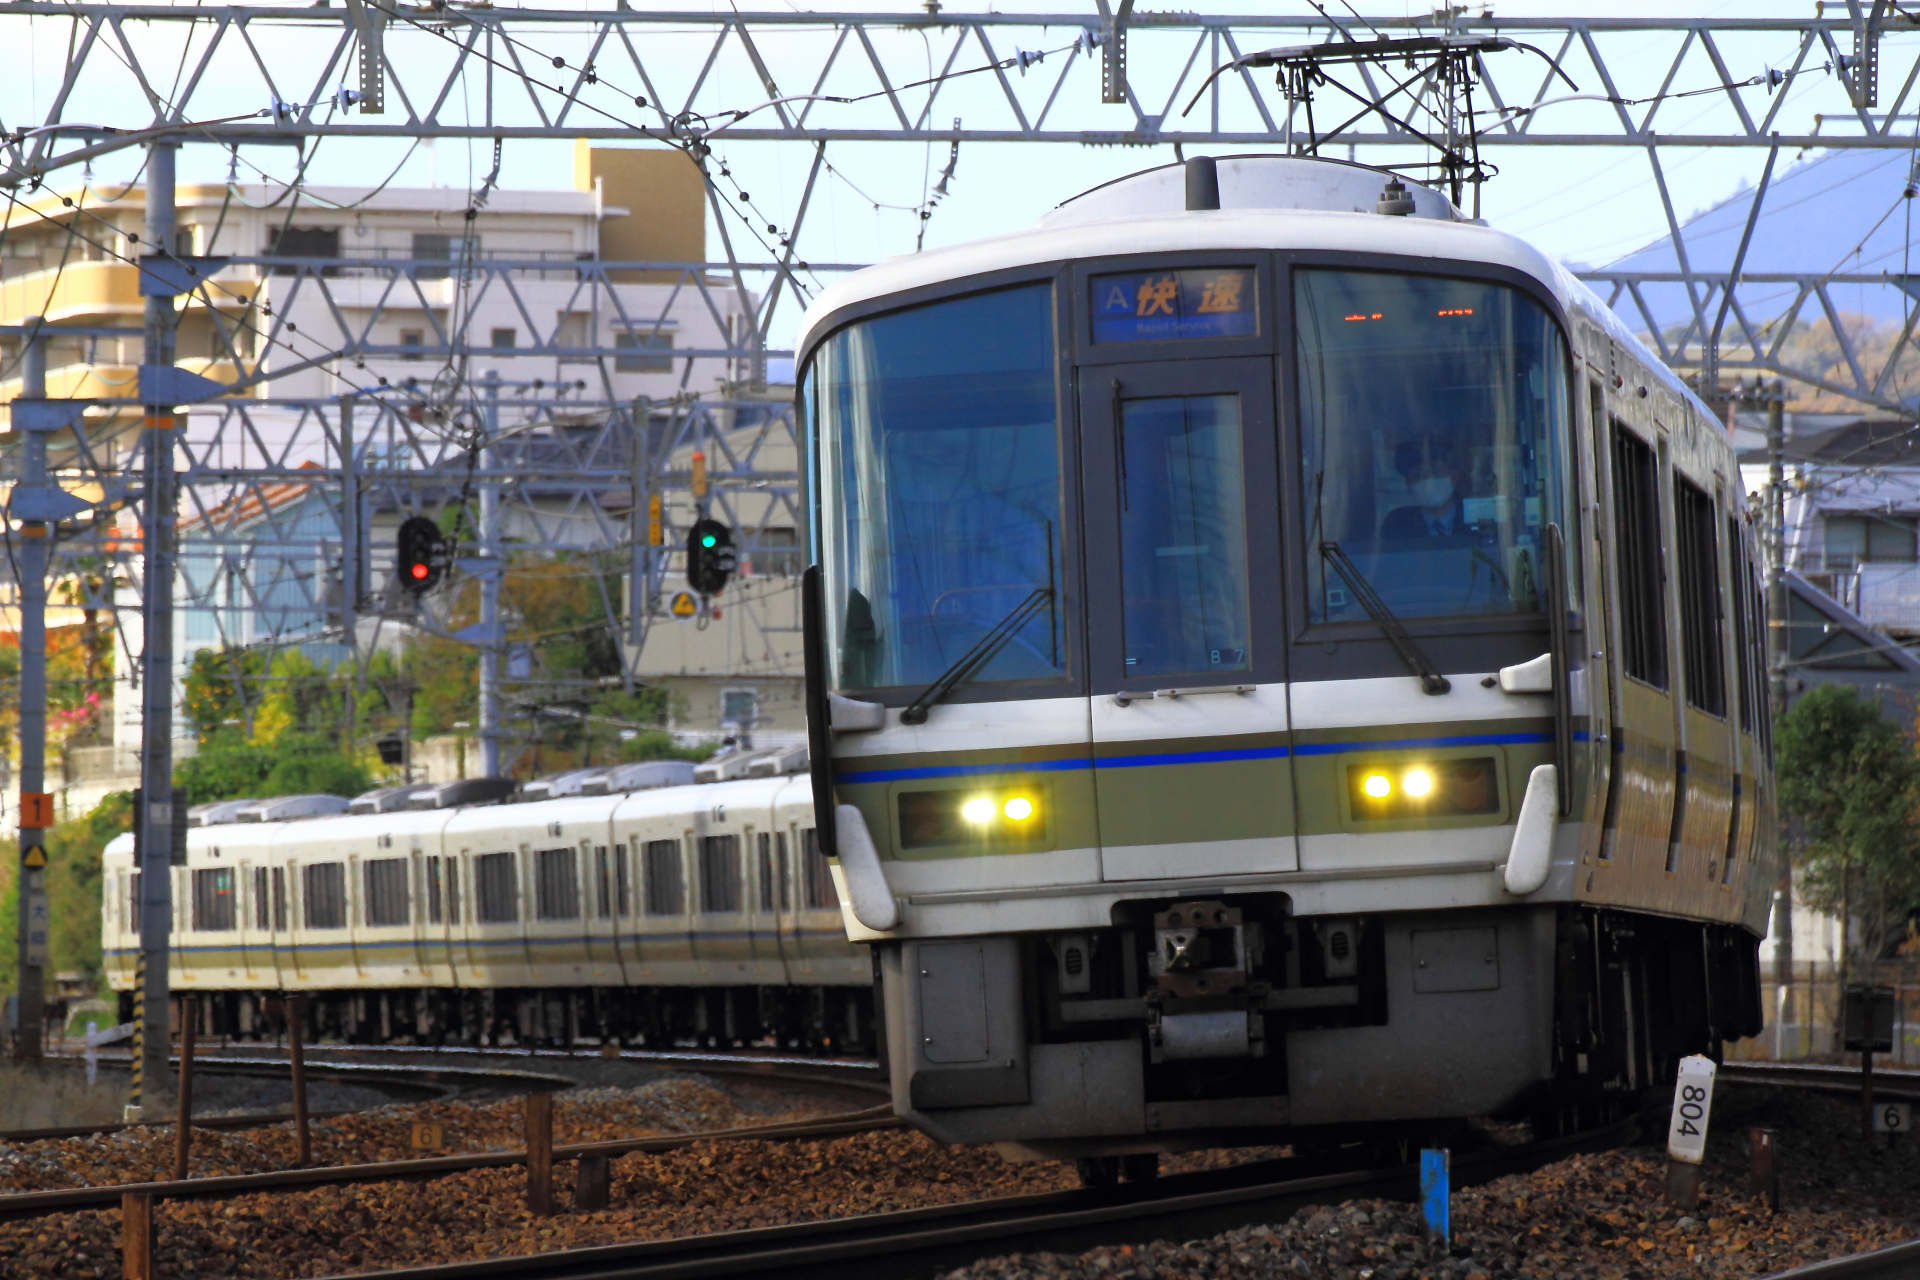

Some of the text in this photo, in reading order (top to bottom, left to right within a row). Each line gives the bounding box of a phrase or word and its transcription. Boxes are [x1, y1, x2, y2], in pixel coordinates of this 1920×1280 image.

[1105, 285, 1129, 310] A
[1136, 273, 1244, 316] 快速
[1137, 320, 1212, 333] Rapid Service
[1210, 648, 1244, 664] B 7
[33, 798, 42, 822] 1
[1676, 1084, 1706, 1137] 804
[1883, 1105, 1901, 1129] 6
[420, 1126, 433, 1146] 6
